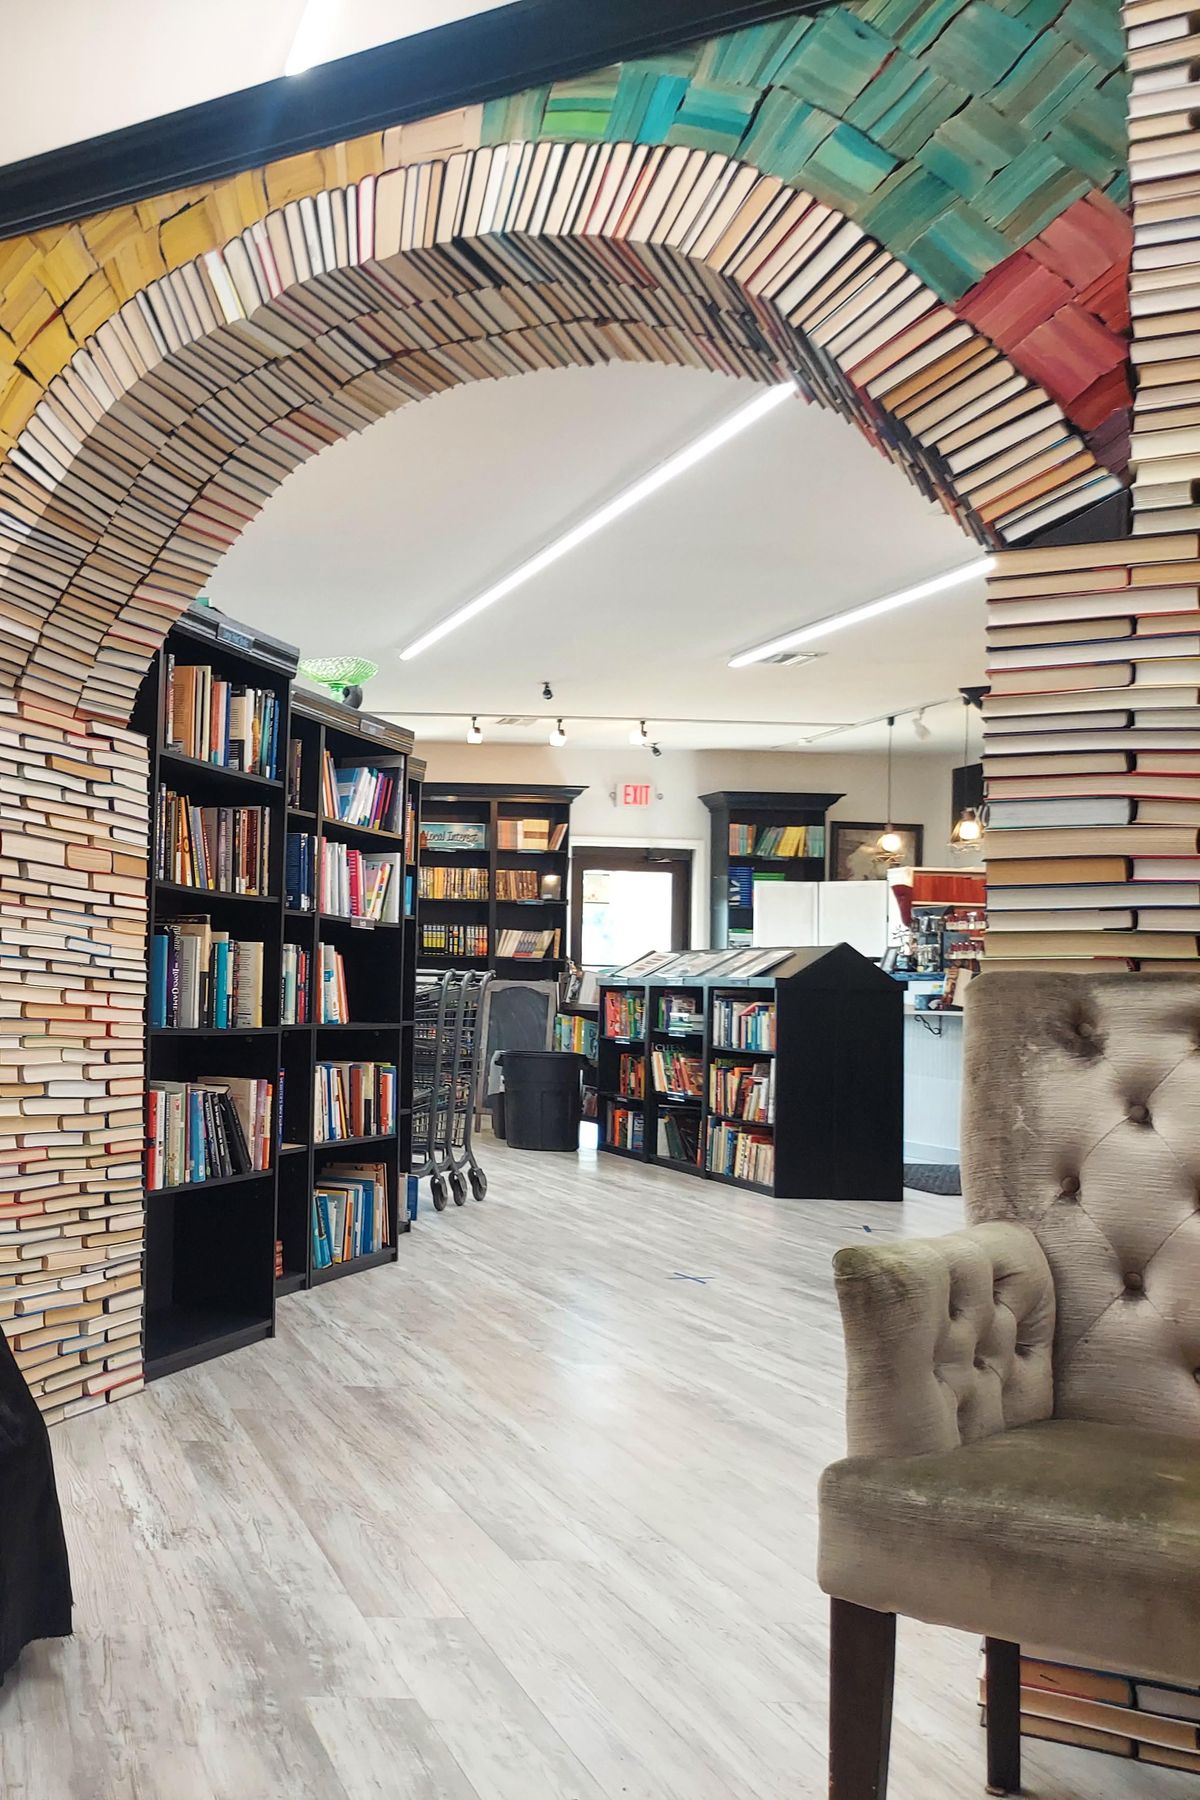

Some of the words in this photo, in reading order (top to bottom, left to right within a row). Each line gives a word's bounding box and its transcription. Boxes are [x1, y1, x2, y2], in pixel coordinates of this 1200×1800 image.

[624, 784, 650, 805] EXIT
[426, 830, 445, 842] Local
[446, 831, 479, 843] Interest
